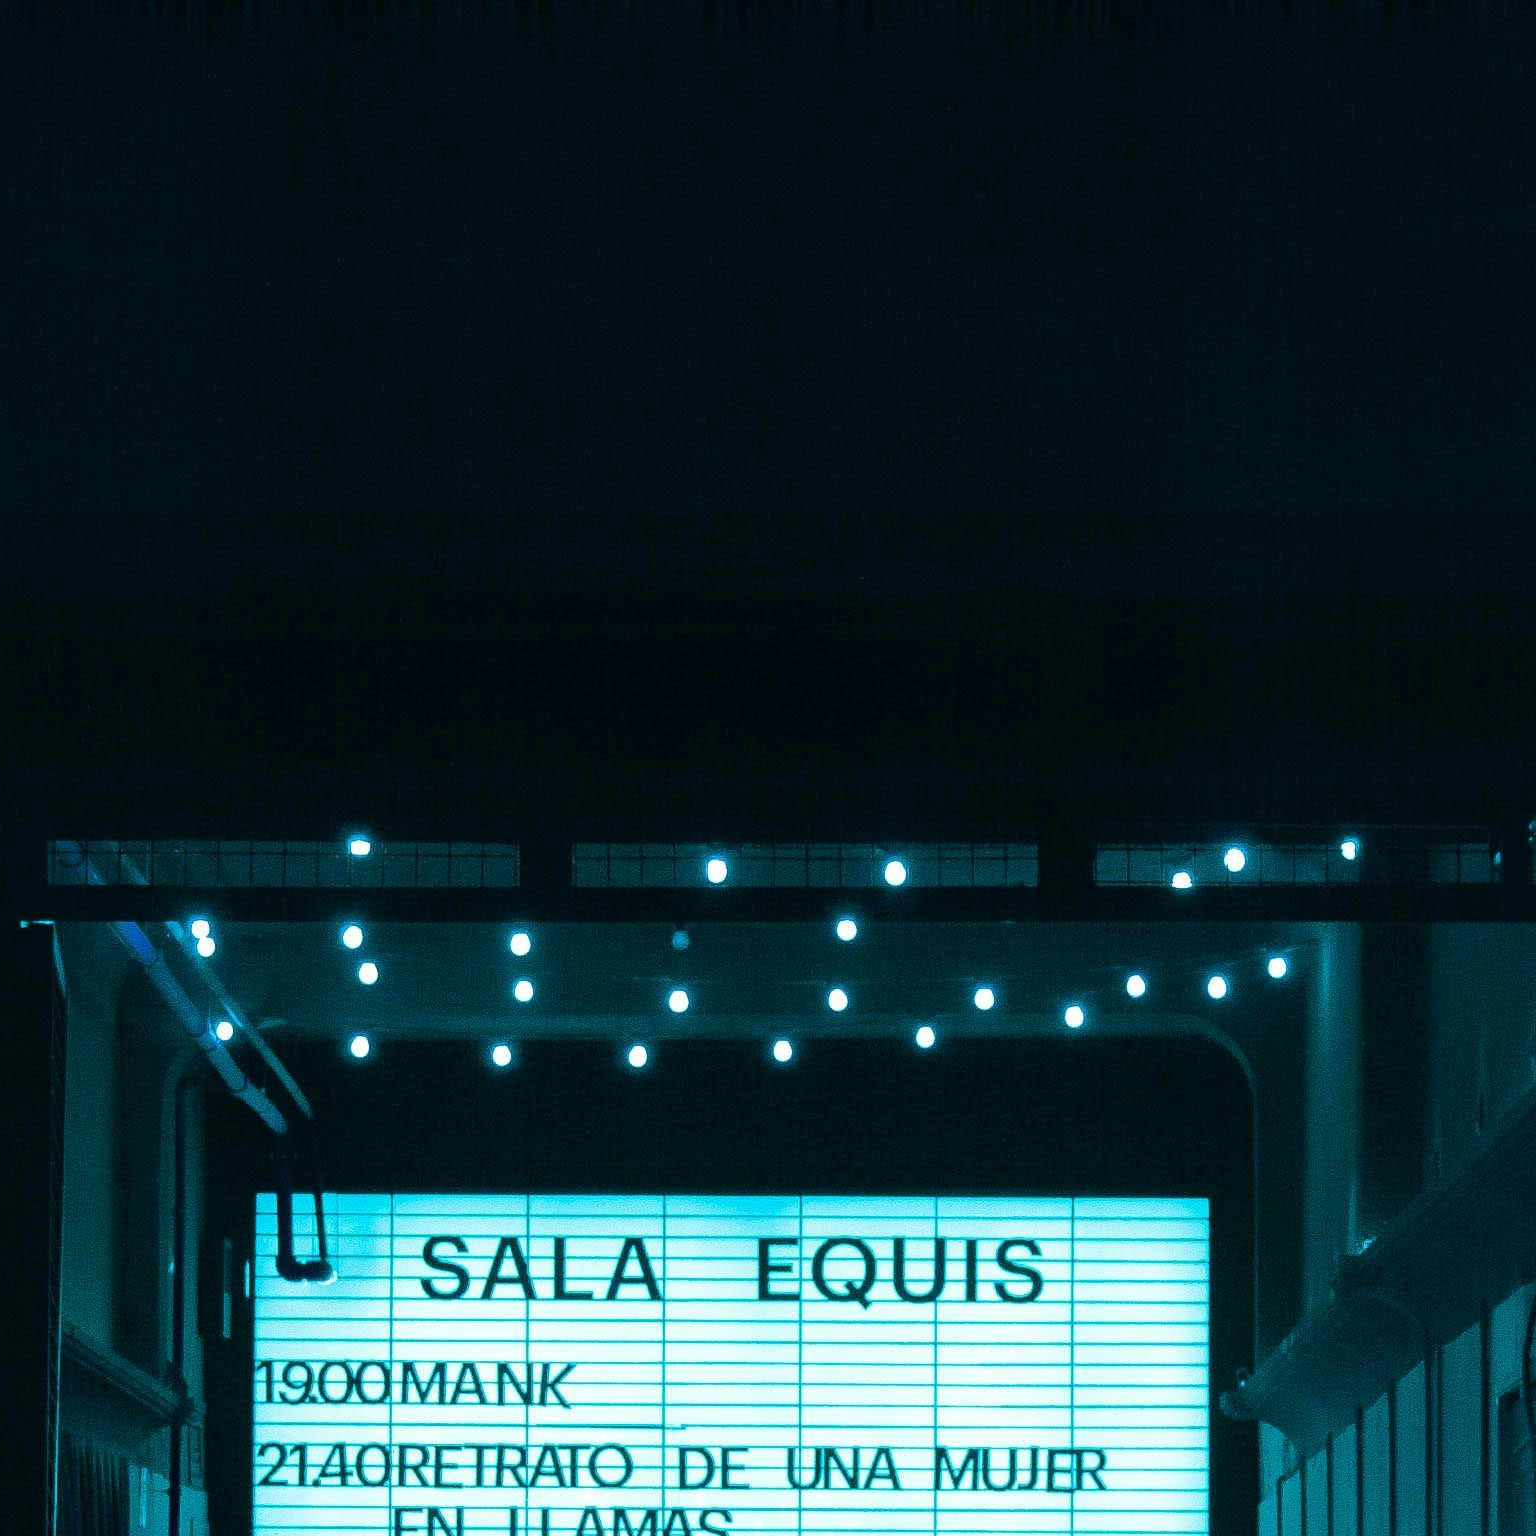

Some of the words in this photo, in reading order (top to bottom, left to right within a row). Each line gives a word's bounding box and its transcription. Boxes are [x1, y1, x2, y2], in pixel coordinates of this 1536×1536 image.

[421, 1236, 662, 1300] SALA
[758, 1237, 1044, 1308] EQUIS
[256, 1360, 391, 1405] 19.00
[402, 1361, 577, 1407] MANK
[257, 1442, 392, 1487] 21.40
[398, 1444, 633, 1488] RETRATO
[678, 1446, 749, 1490] DE
[786, 1446, 900, 1490] UNA
[935, 1446, 1107, 1492] MUJER
